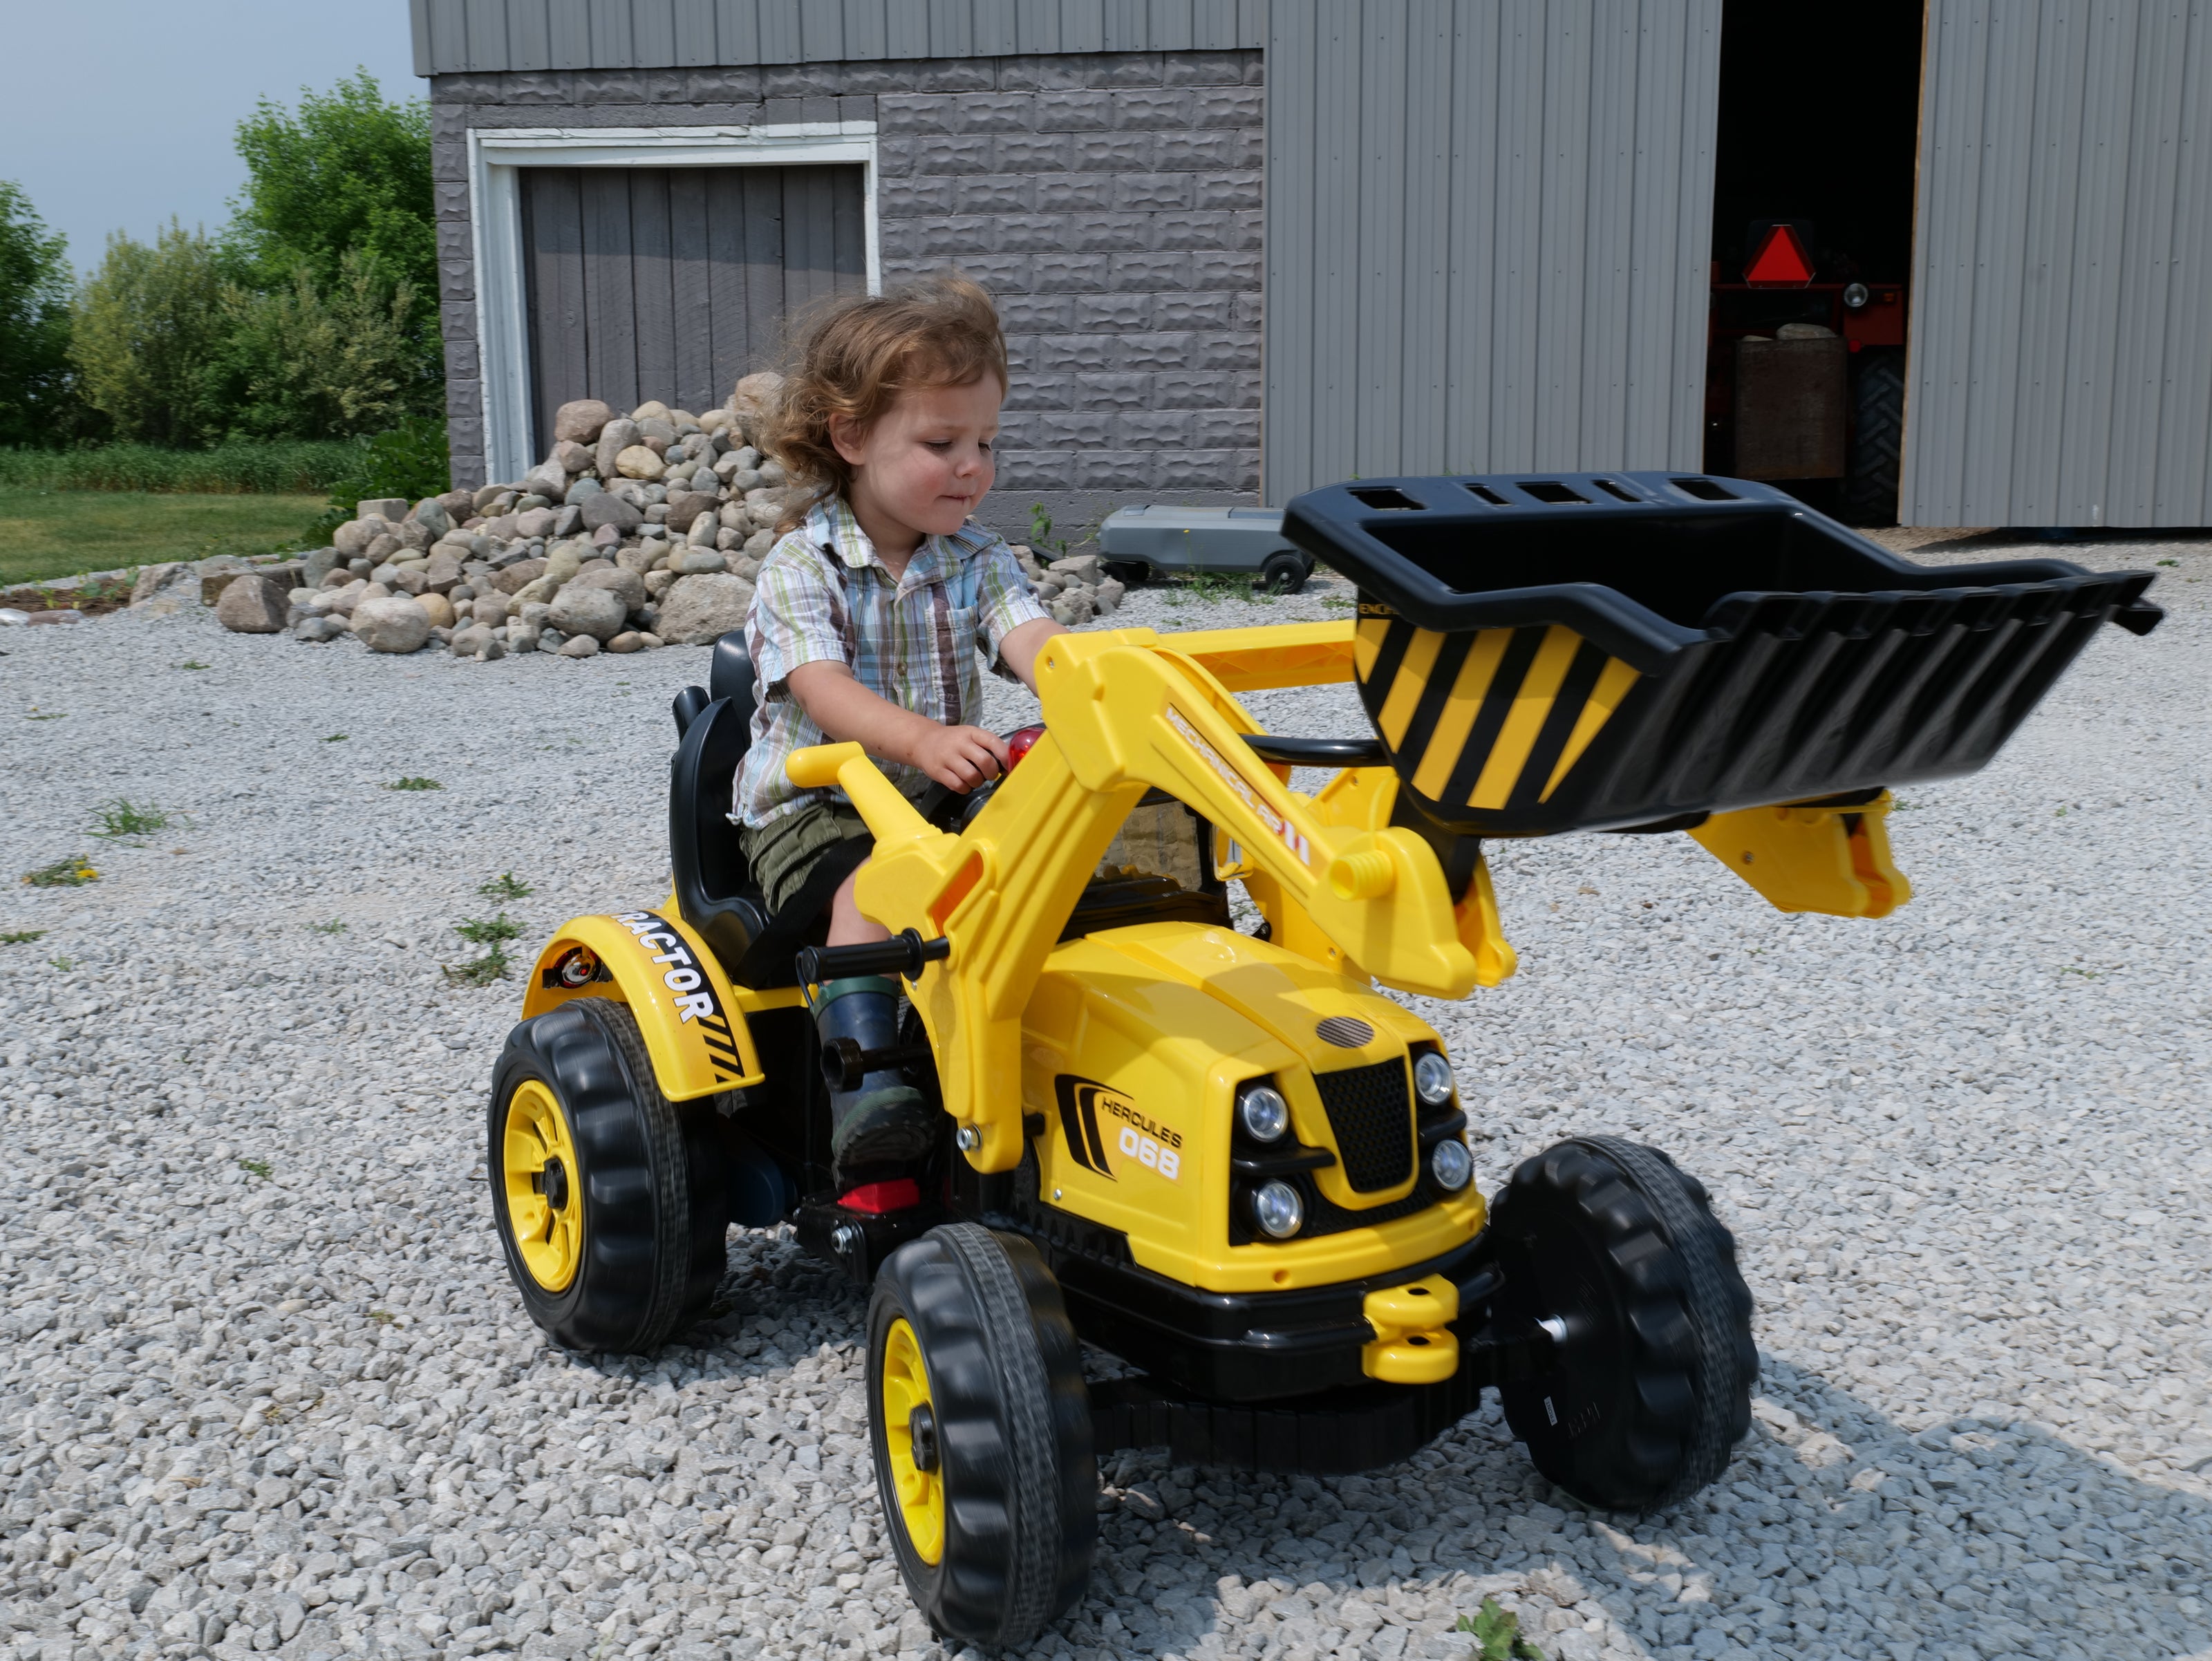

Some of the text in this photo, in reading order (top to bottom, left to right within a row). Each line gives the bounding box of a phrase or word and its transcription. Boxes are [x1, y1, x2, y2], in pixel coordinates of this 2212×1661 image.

[1165, 707, 1255, 809] MECHANICAL
[610, 911, 713, 1024] RACTOR
[1101, 1096, 1183, 1149] HERCULES
[1118, 1126, 1181, 1181] 068
[1546, 1400, 1555, 1423] FRONT
